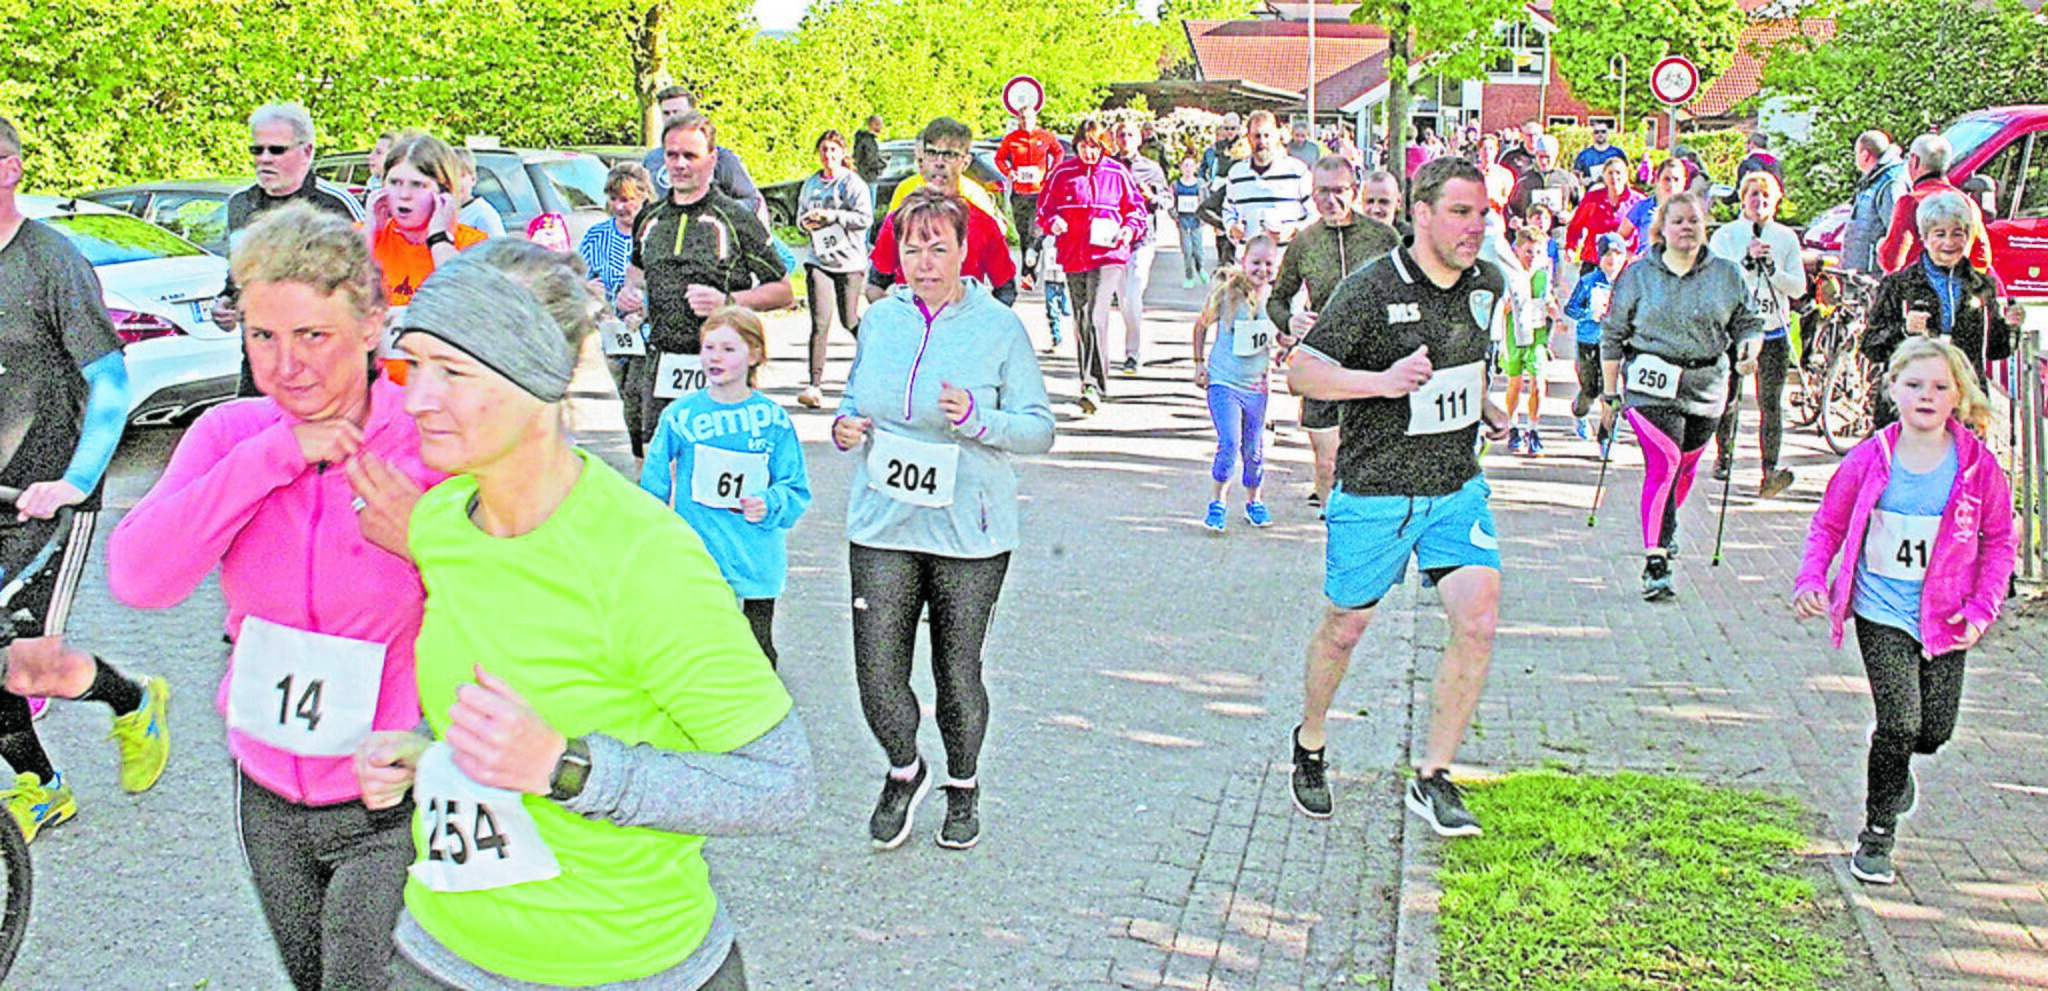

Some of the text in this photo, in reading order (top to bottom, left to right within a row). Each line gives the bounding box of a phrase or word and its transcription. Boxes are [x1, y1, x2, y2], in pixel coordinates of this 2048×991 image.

[672, 368, 706, 390] 270
[1638, 367, 1668, 390] 250
[1435, 388, 1467, 422] 111
[717, 471, 745, 499] 61
[886, 458, 937, 495] 204
[1896, 539, 1927, 568] 41
[274, 673, 324, 731] 14
[427, 796, 510, 865] 254
